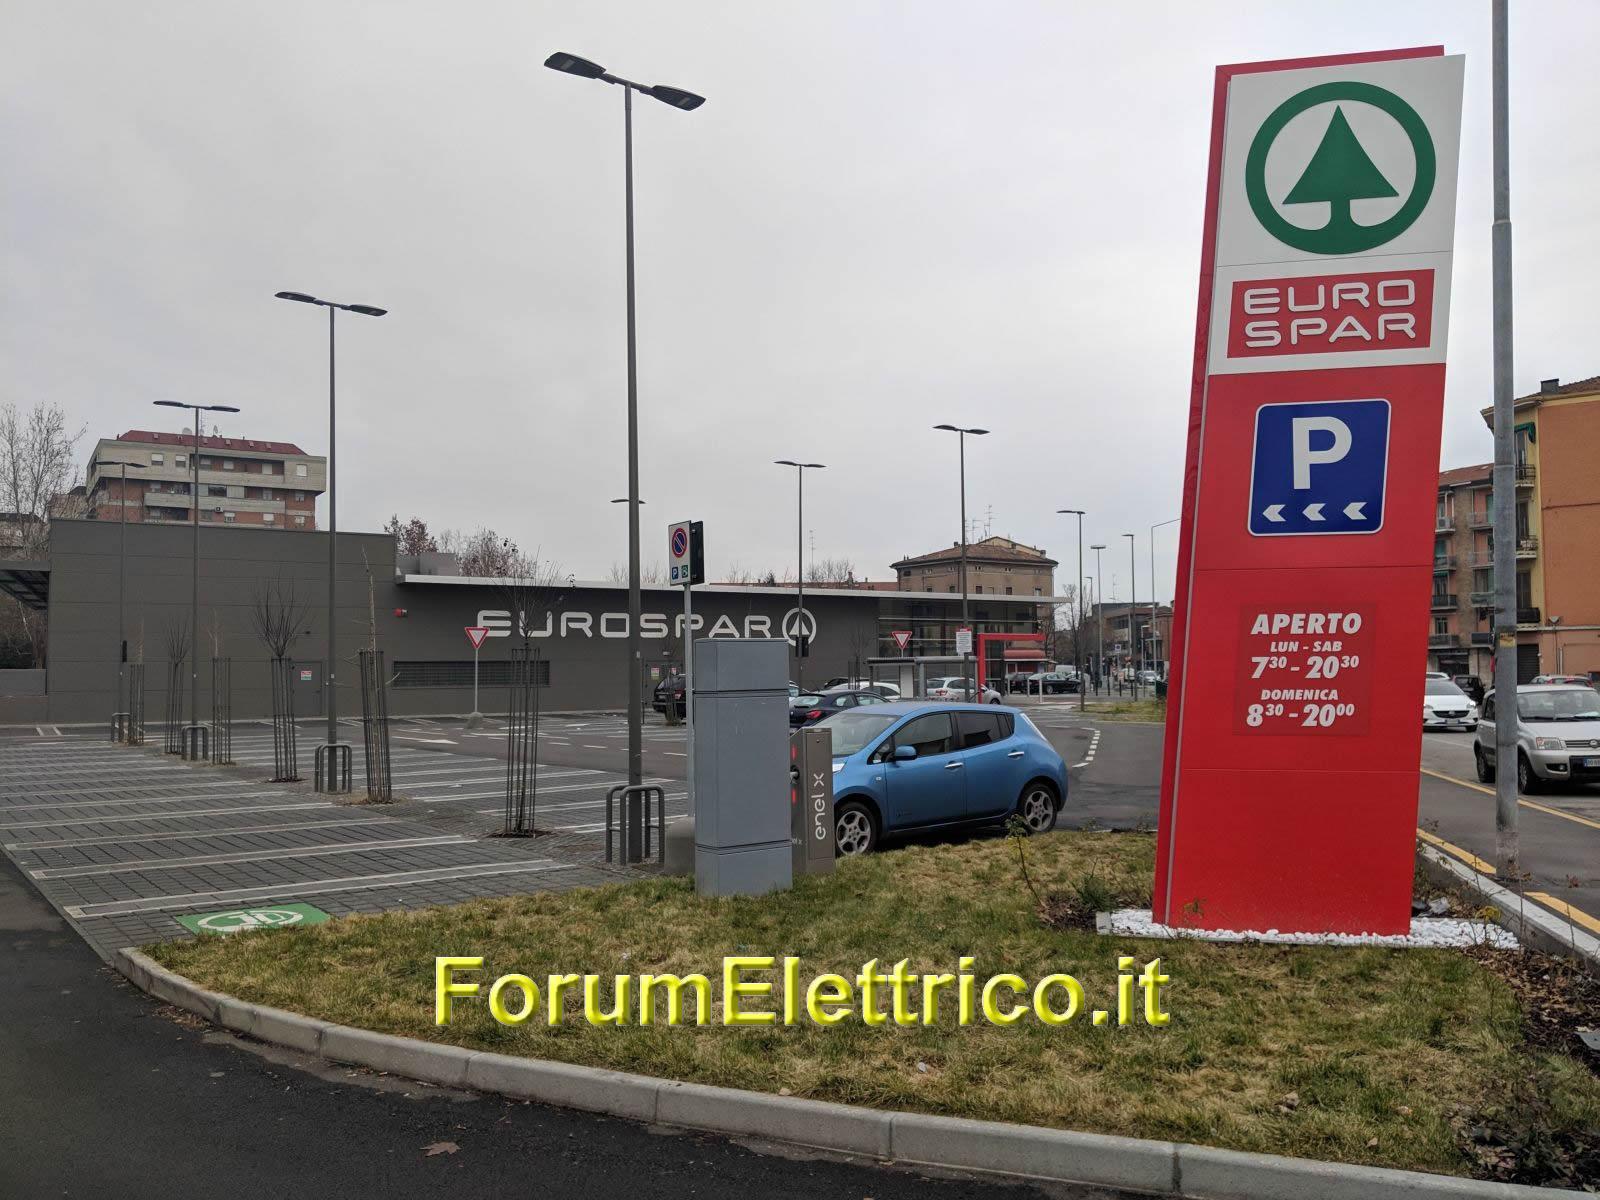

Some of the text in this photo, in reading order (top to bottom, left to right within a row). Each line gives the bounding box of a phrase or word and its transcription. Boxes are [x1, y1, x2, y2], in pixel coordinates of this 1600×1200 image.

[1244, 279, 1415, 314] EURO
[1245, 313, 1416, 347] SPAR
[1292, 416, 1352, 489] P
[477, 610, 771, 637] EUROSPAR
[1250, 613, 1362, 635] APERTO
[1270, 642, 1299, 652] LUN
[1313, 641, 1342, 652] SAB
[1261, 689, 1338, 700] DOMENICA
[811, 773, 826, 840] enel x
